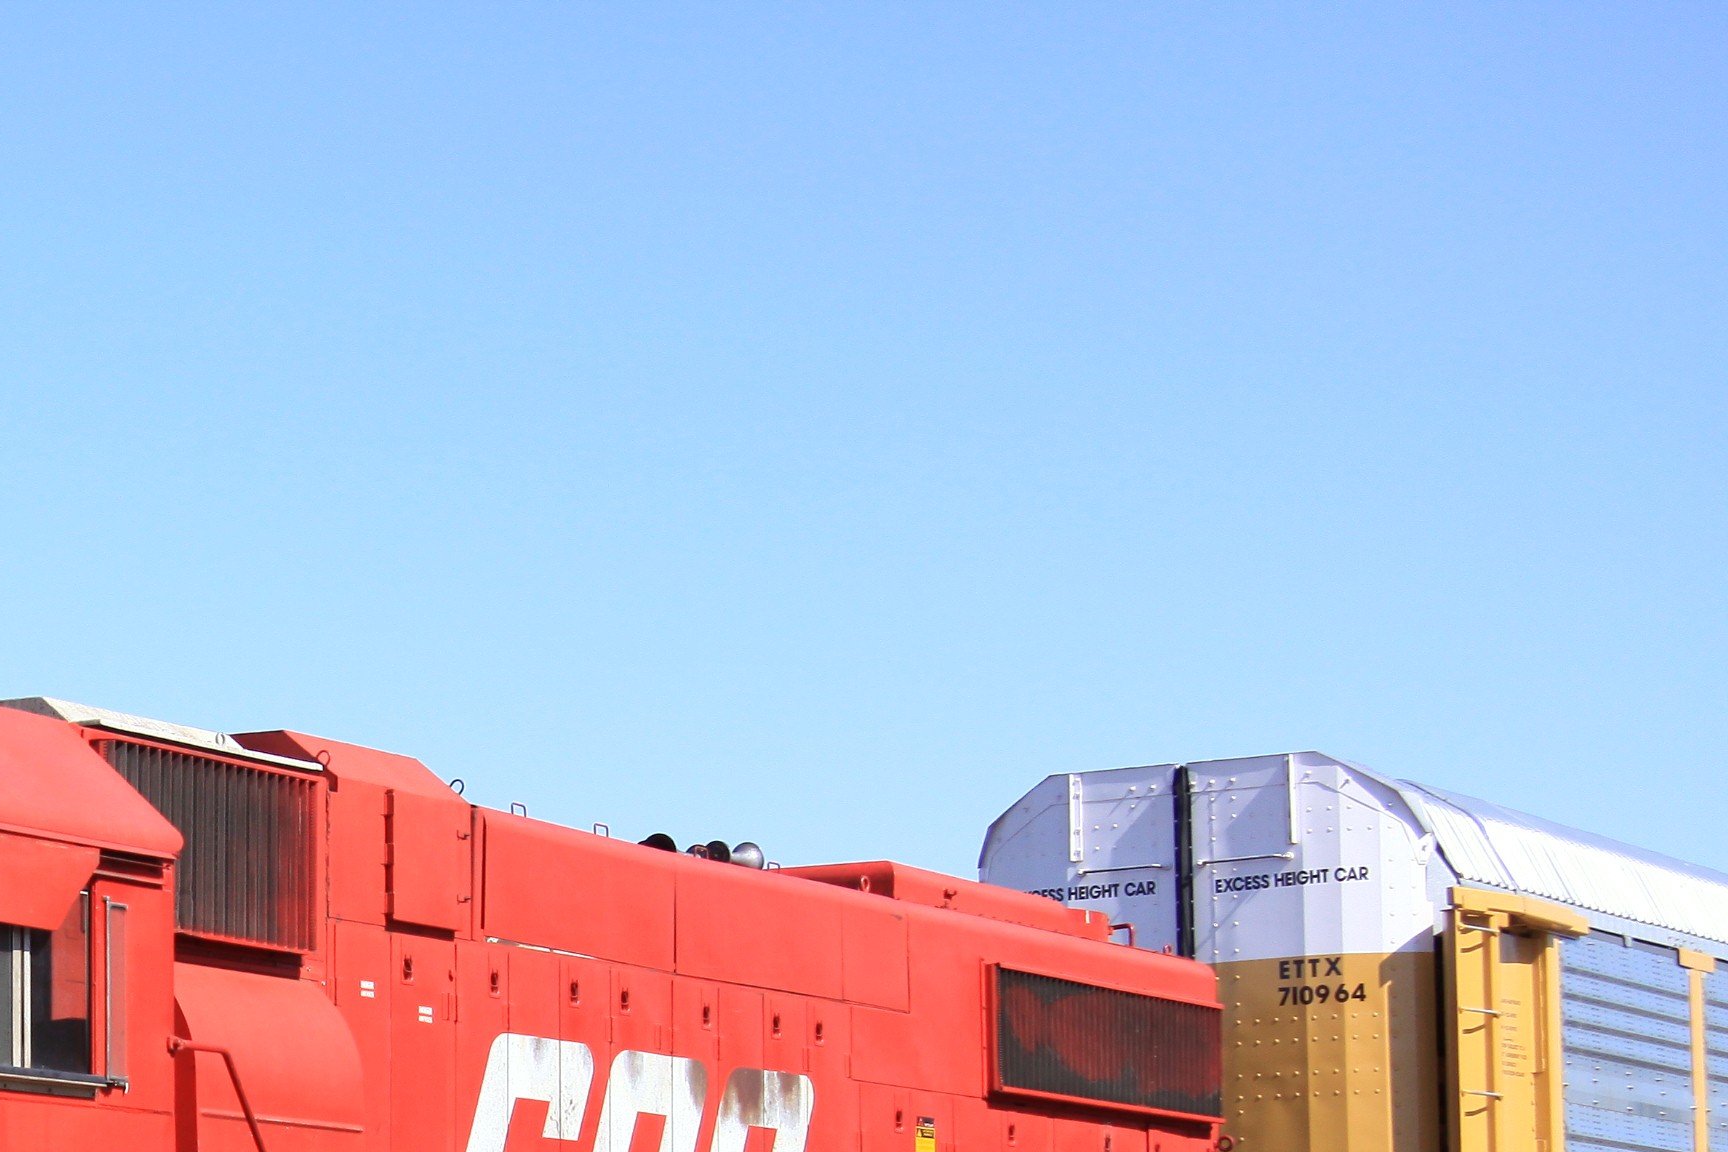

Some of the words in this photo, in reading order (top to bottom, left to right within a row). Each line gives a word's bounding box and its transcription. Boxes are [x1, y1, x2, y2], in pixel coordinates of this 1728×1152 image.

[1068, 883, 1120, 900] HEIGHT
[1124, 880, 1156, 897] CAR
[1215, 874, 1270, 894] EXCESS
[1274, 868, 1329, 888] HEIGHT
[1336, 866, 1369, 882] CAR
[1279, 957, 1342, 980] ETTX
[1278, 983, 1367, 1007] 710964
